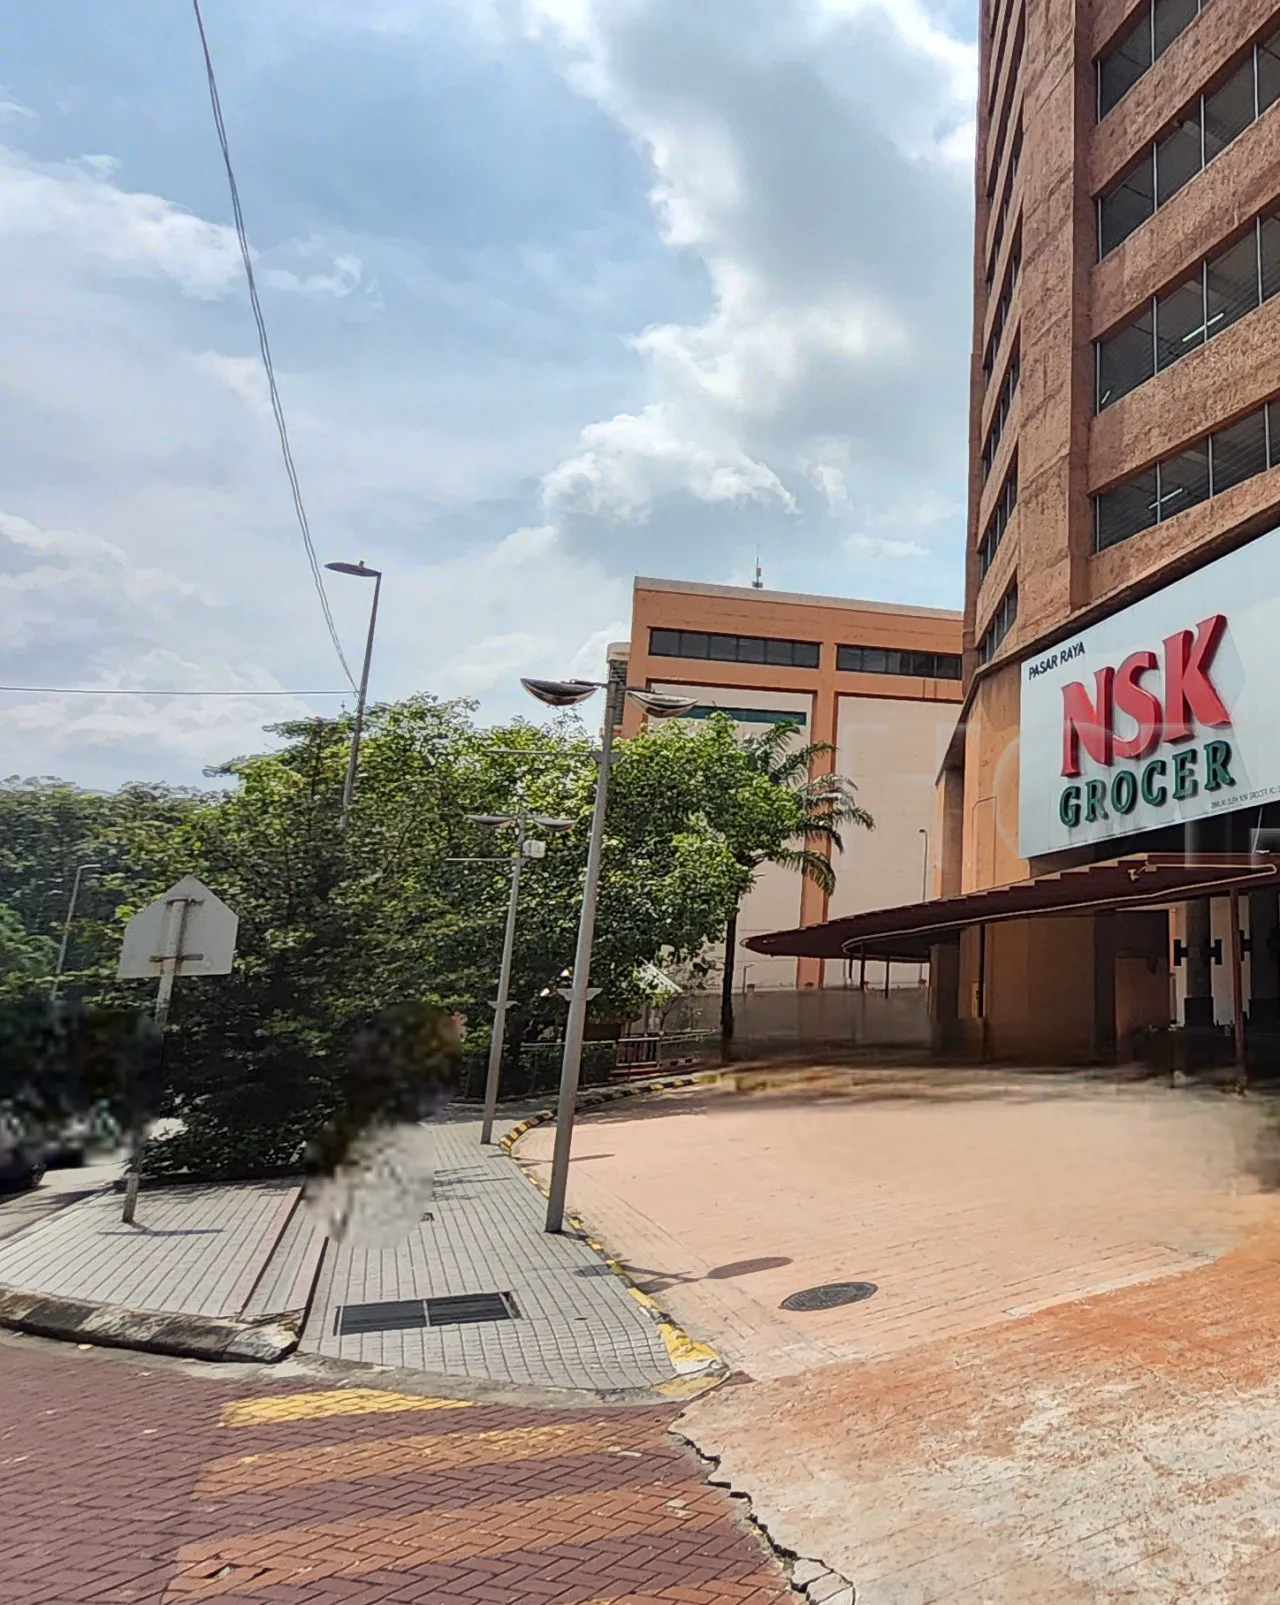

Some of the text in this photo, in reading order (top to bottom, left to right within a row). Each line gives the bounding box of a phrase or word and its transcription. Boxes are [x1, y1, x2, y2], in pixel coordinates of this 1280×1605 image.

[1028, 641, 1085, 681] PASAR RAYA
[1060, 614, 1233, 778] NSK
[1059, 740, 1237, 828] GROCER
